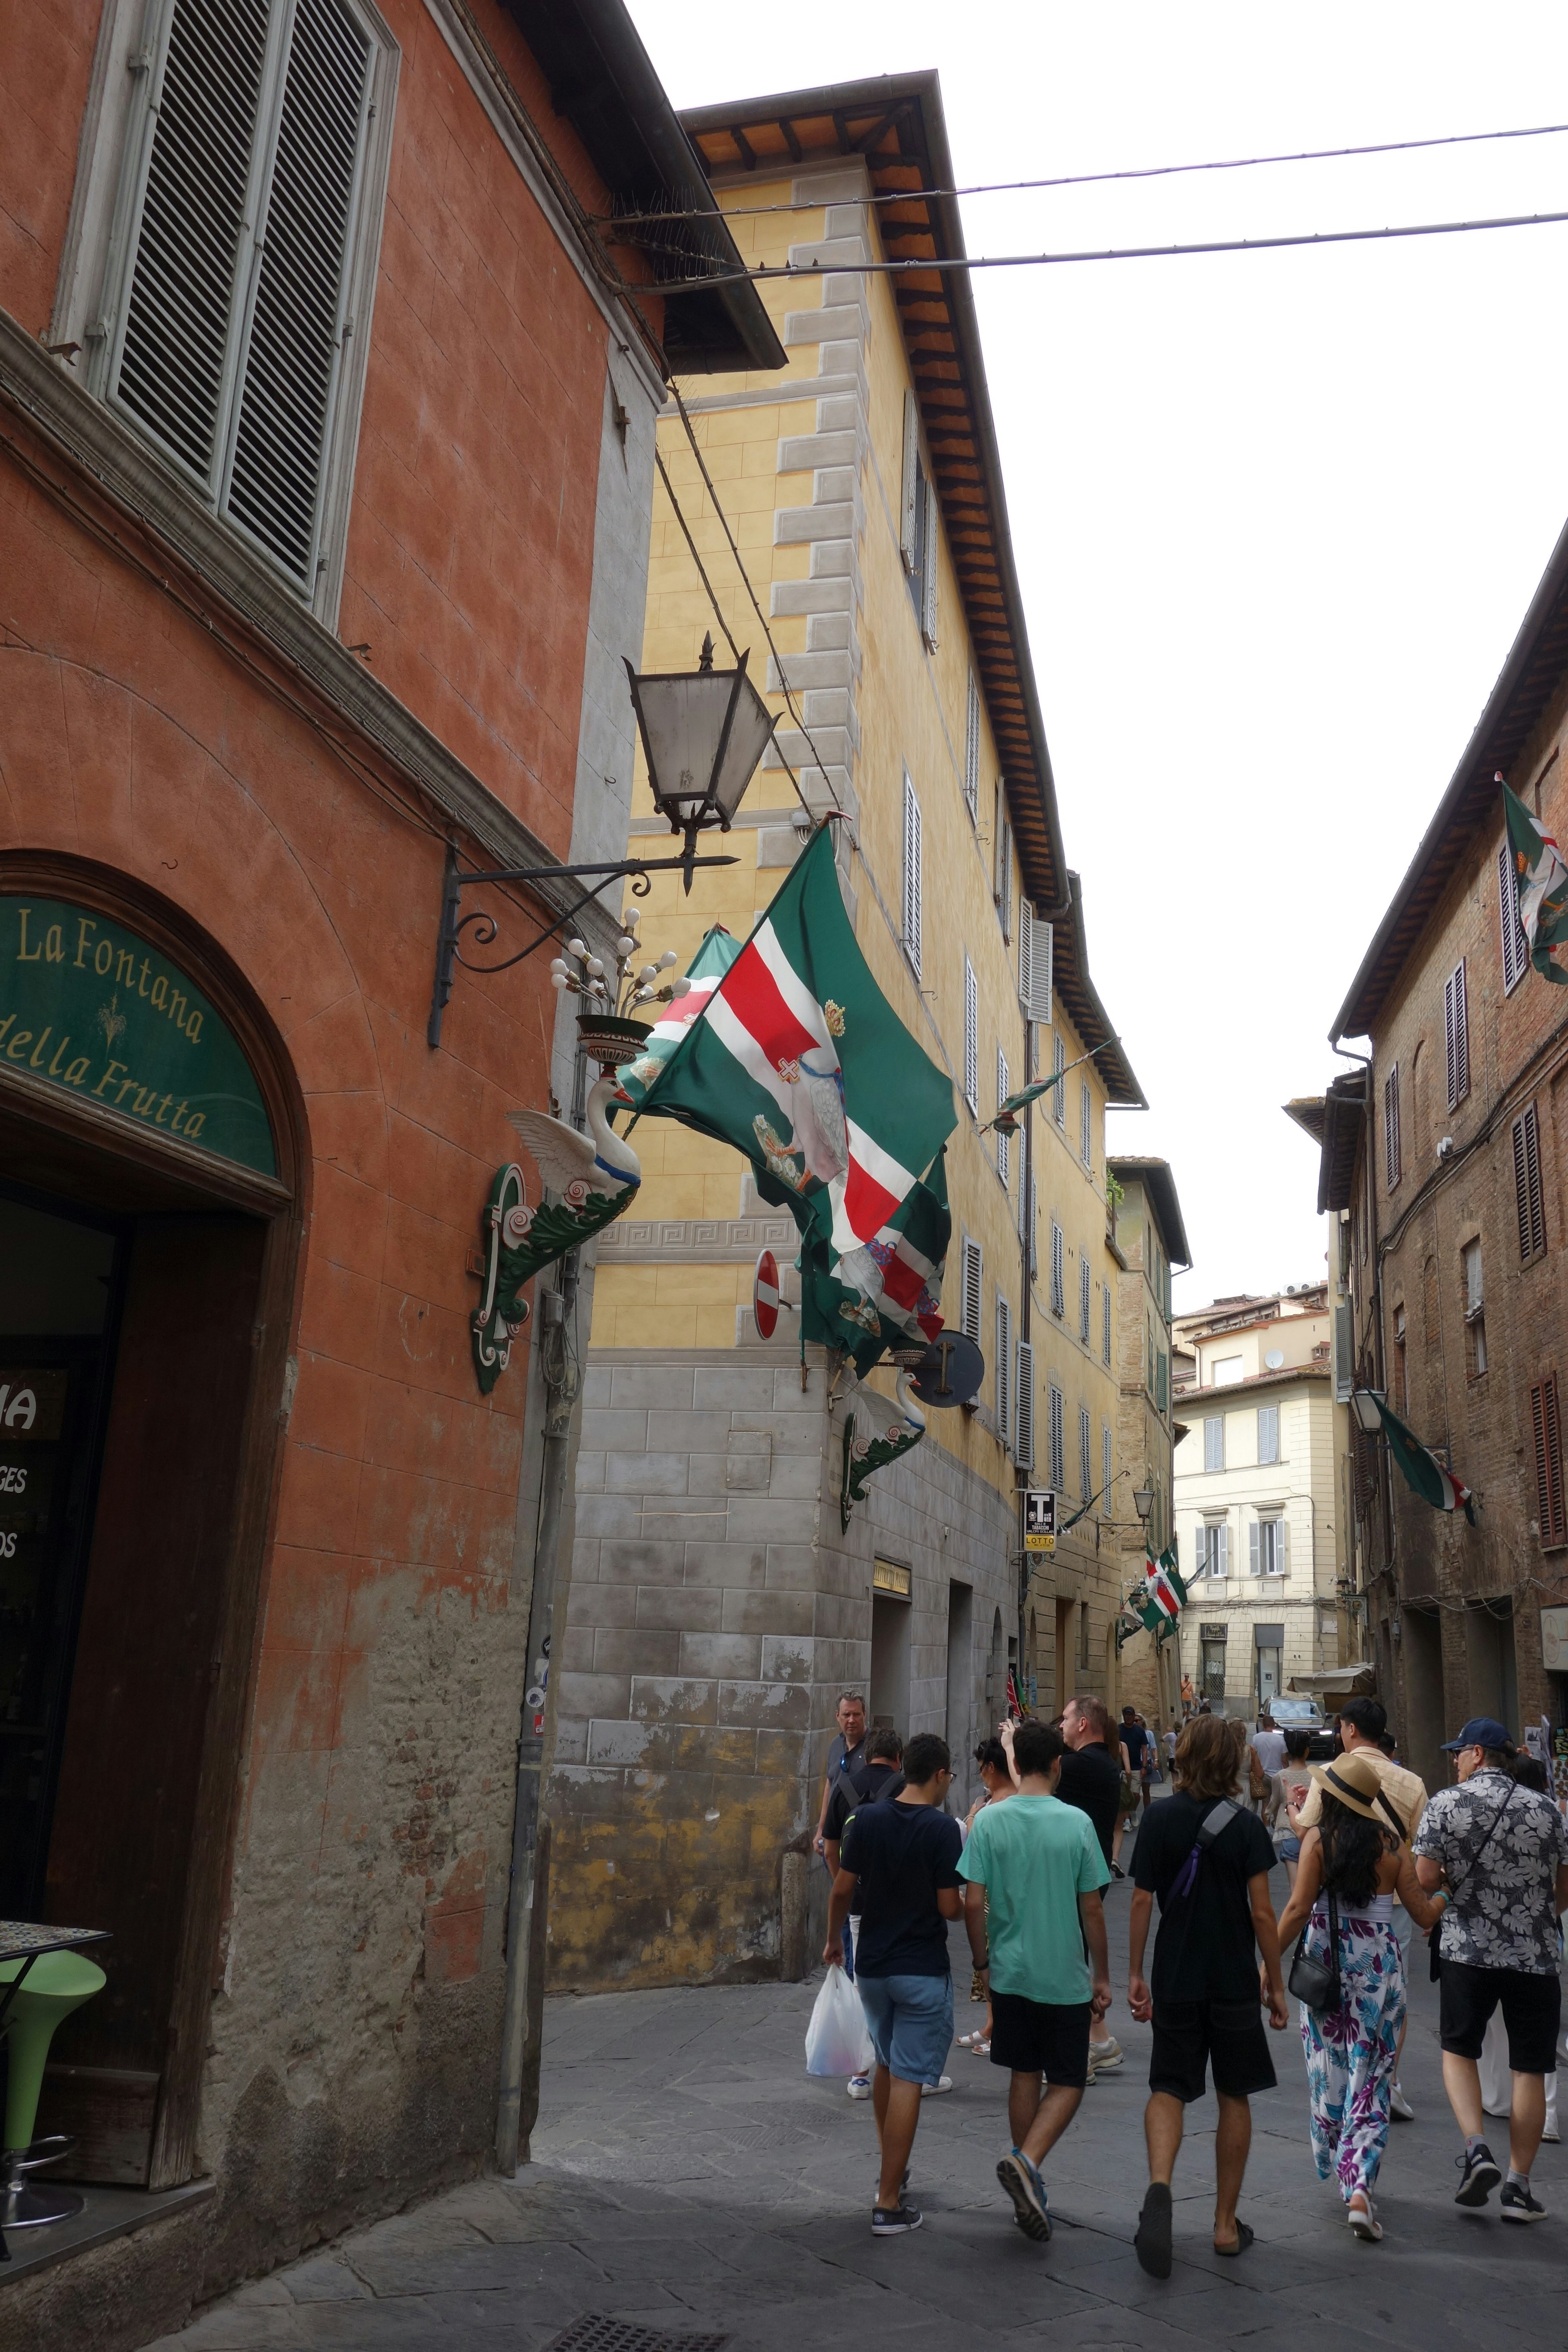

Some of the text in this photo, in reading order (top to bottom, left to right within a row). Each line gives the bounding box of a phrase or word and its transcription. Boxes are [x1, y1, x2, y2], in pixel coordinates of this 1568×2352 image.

[17, 909, 205, 1044] La Fontana
[91, 1060, 207, 1139] Frutta
[1031, 1494, 1050, 1522] T
